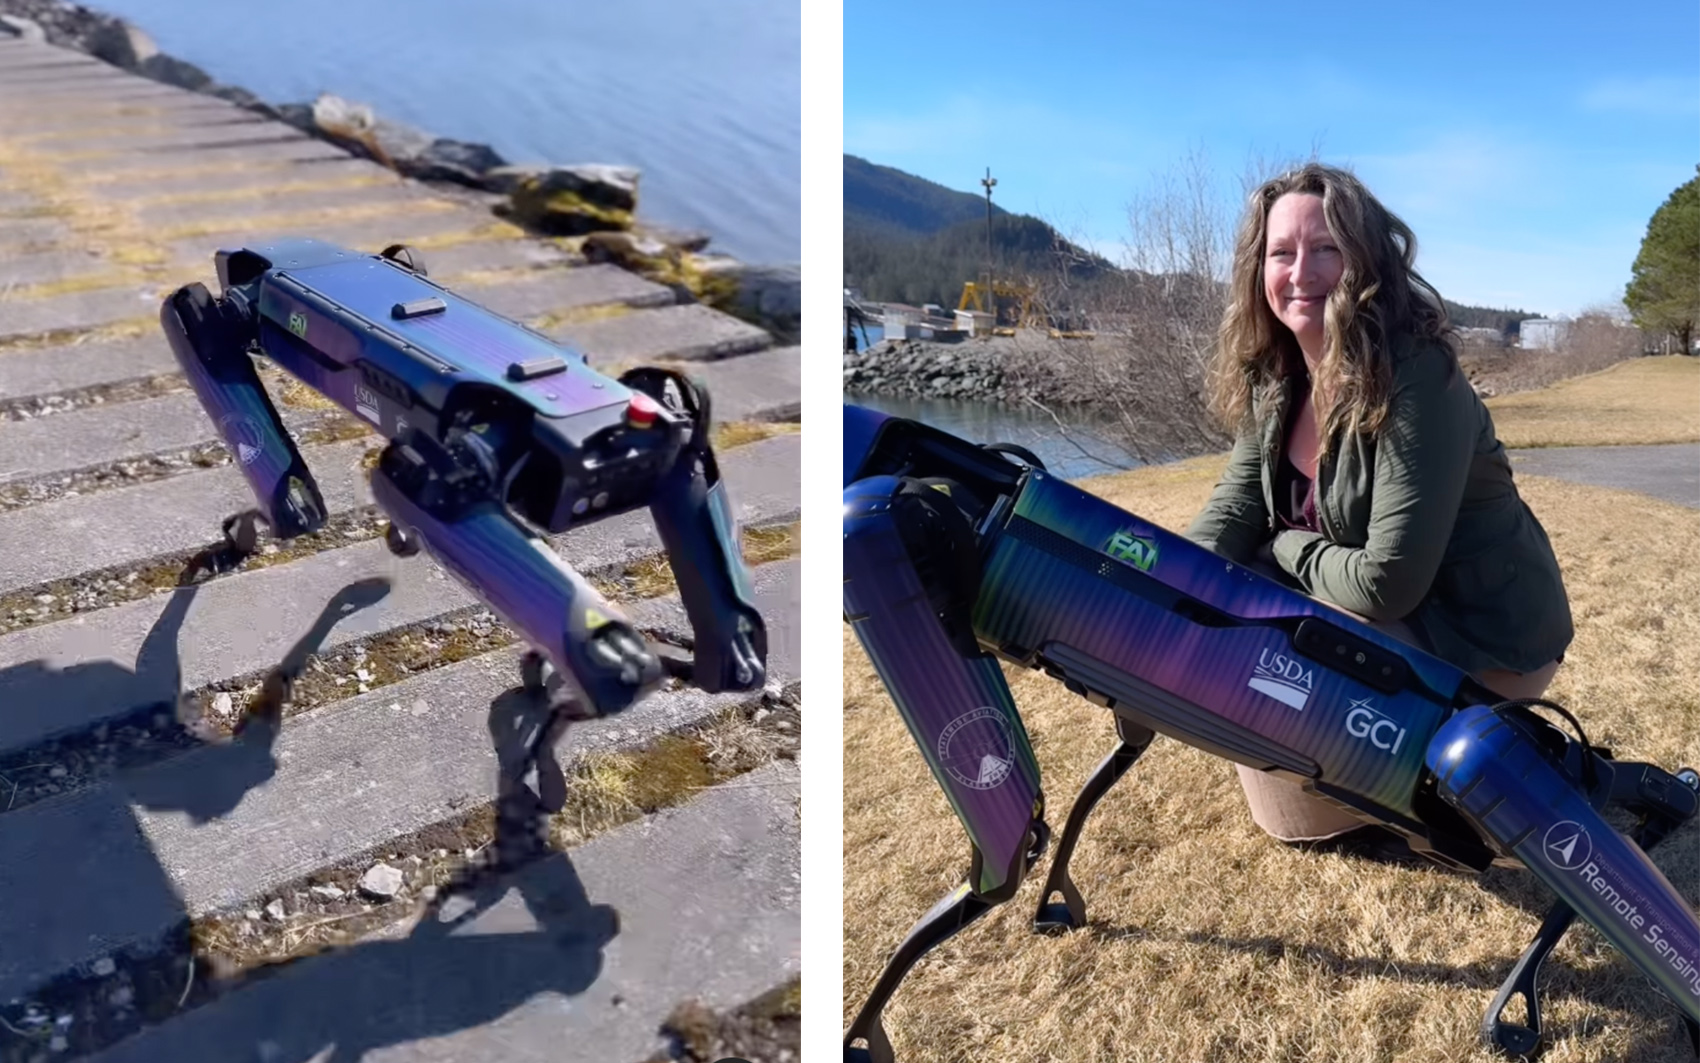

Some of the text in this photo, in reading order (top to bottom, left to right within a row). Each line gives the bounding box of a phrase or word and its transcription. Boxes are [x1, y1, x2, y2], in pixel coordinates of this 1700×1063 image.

[354, 384, 379, 410] USDA
[1107, 533, 1156, 571] FAI
[1259, 648, 1313, 690] USDA
[1346, 708, 1406, 755] GCI
[1579, 861, 1645, 931] Remote
[1594, 852, 1636, 897] Department
[1636, 895, 1646, 906] of
[1642, 897, 1693, 952] Transportation
